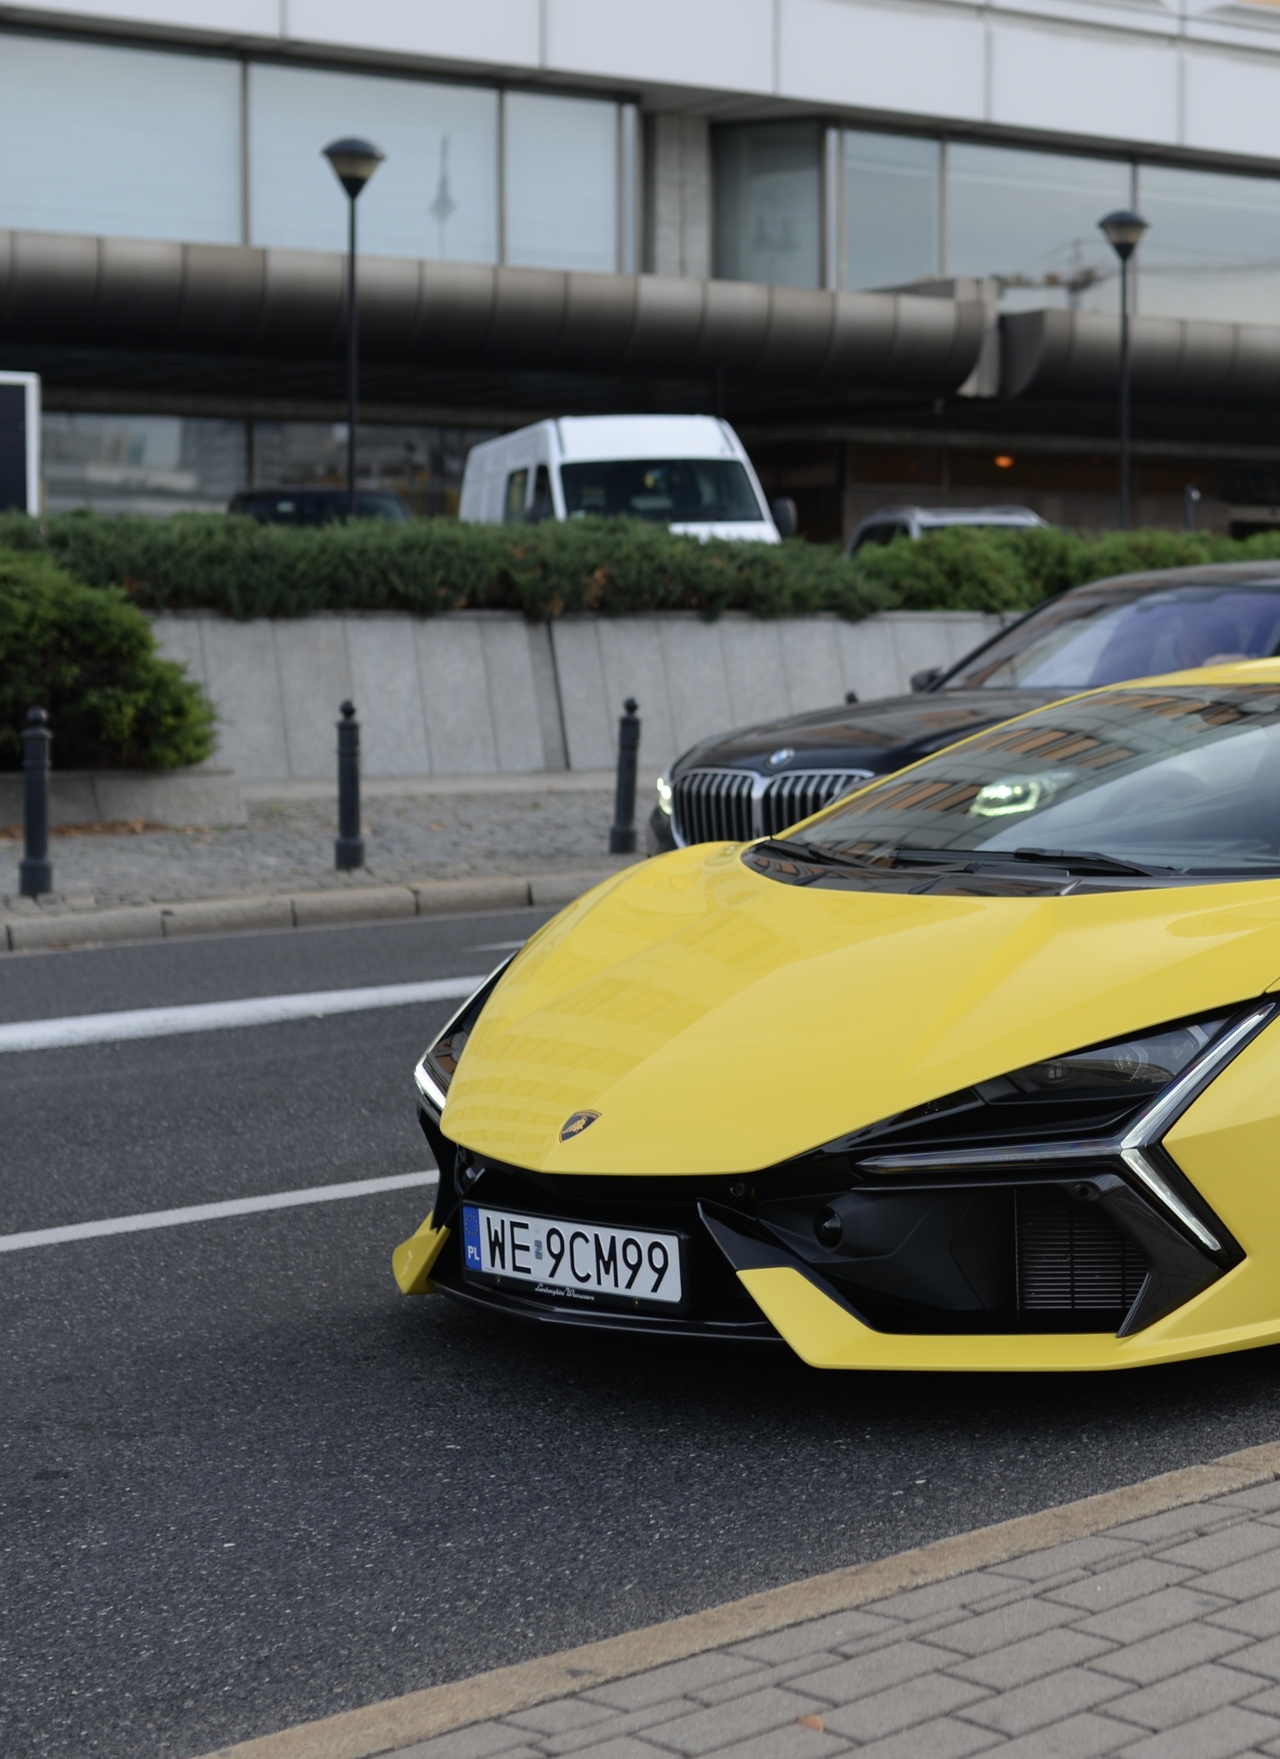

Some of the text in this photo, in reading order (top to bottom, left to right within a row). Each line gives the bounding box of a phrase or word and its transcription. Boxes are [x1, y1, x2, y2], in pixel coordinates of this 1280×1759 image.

[468, 1245, 480, 1261] PL
[486, 1216, 669, 1293] WE 9CM99
